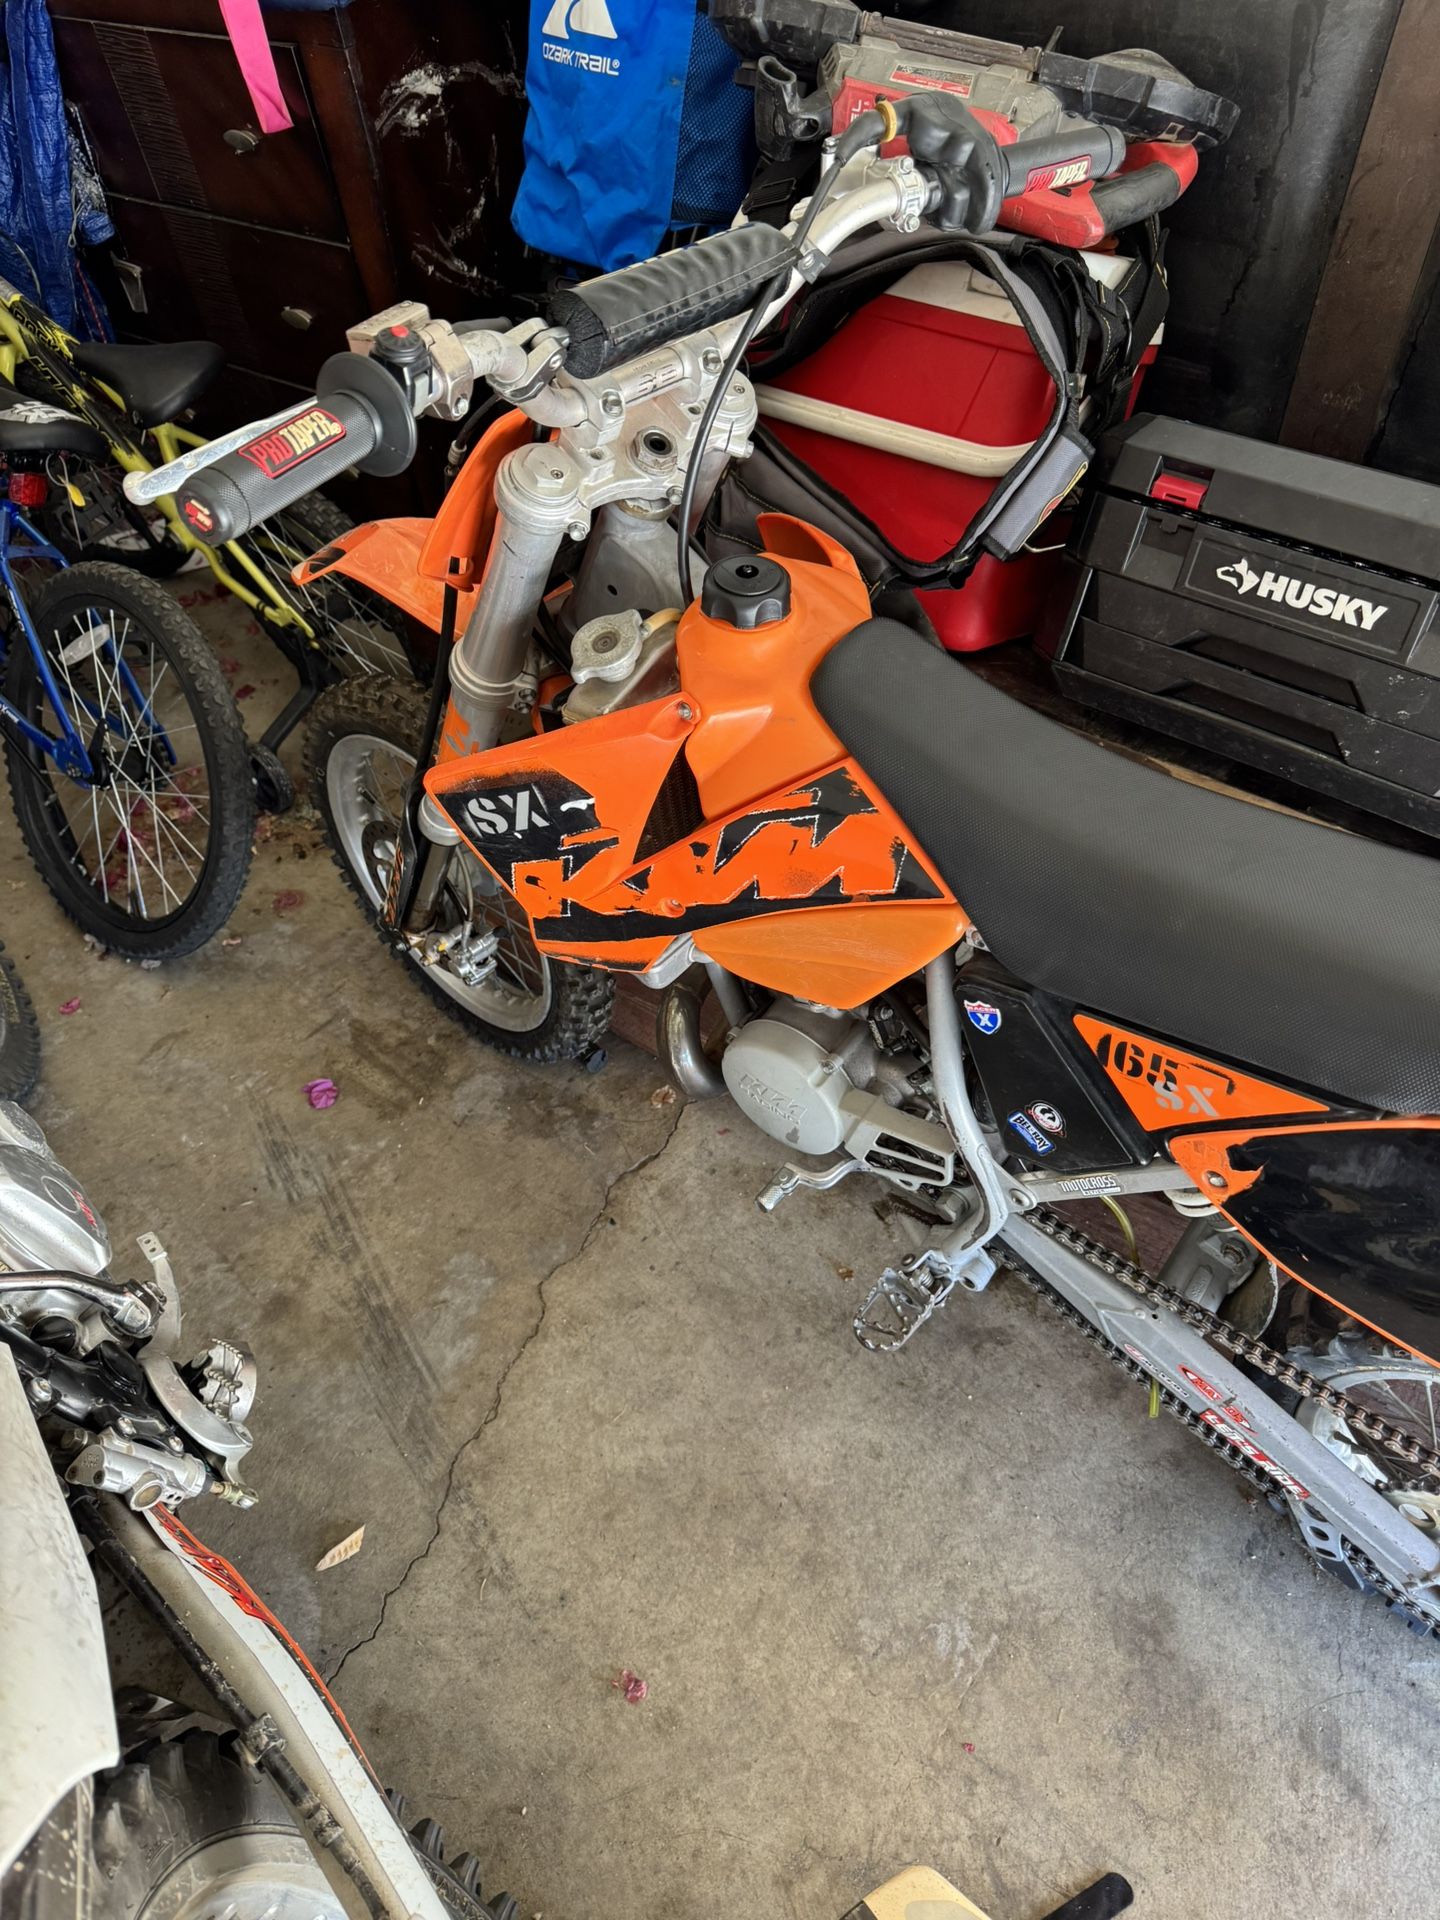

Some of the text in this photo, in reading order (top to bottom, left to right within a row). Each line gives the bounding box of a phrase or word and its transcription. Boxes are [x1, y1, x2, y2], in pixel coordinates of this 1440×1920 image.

[1256, 570, 1388, 631] HUSKY
[467, 790, 551, 835] SX
[976, 1012, 994, 1027] X
[1012, 1114, 1051, 1150] BEL-RAY
[1058, 1175, 1117, 1195] MOTOCROSS
[1203, 1410, 1261, 1456] LET'S
[1258, 1460, 1305, 1500] RIDE
